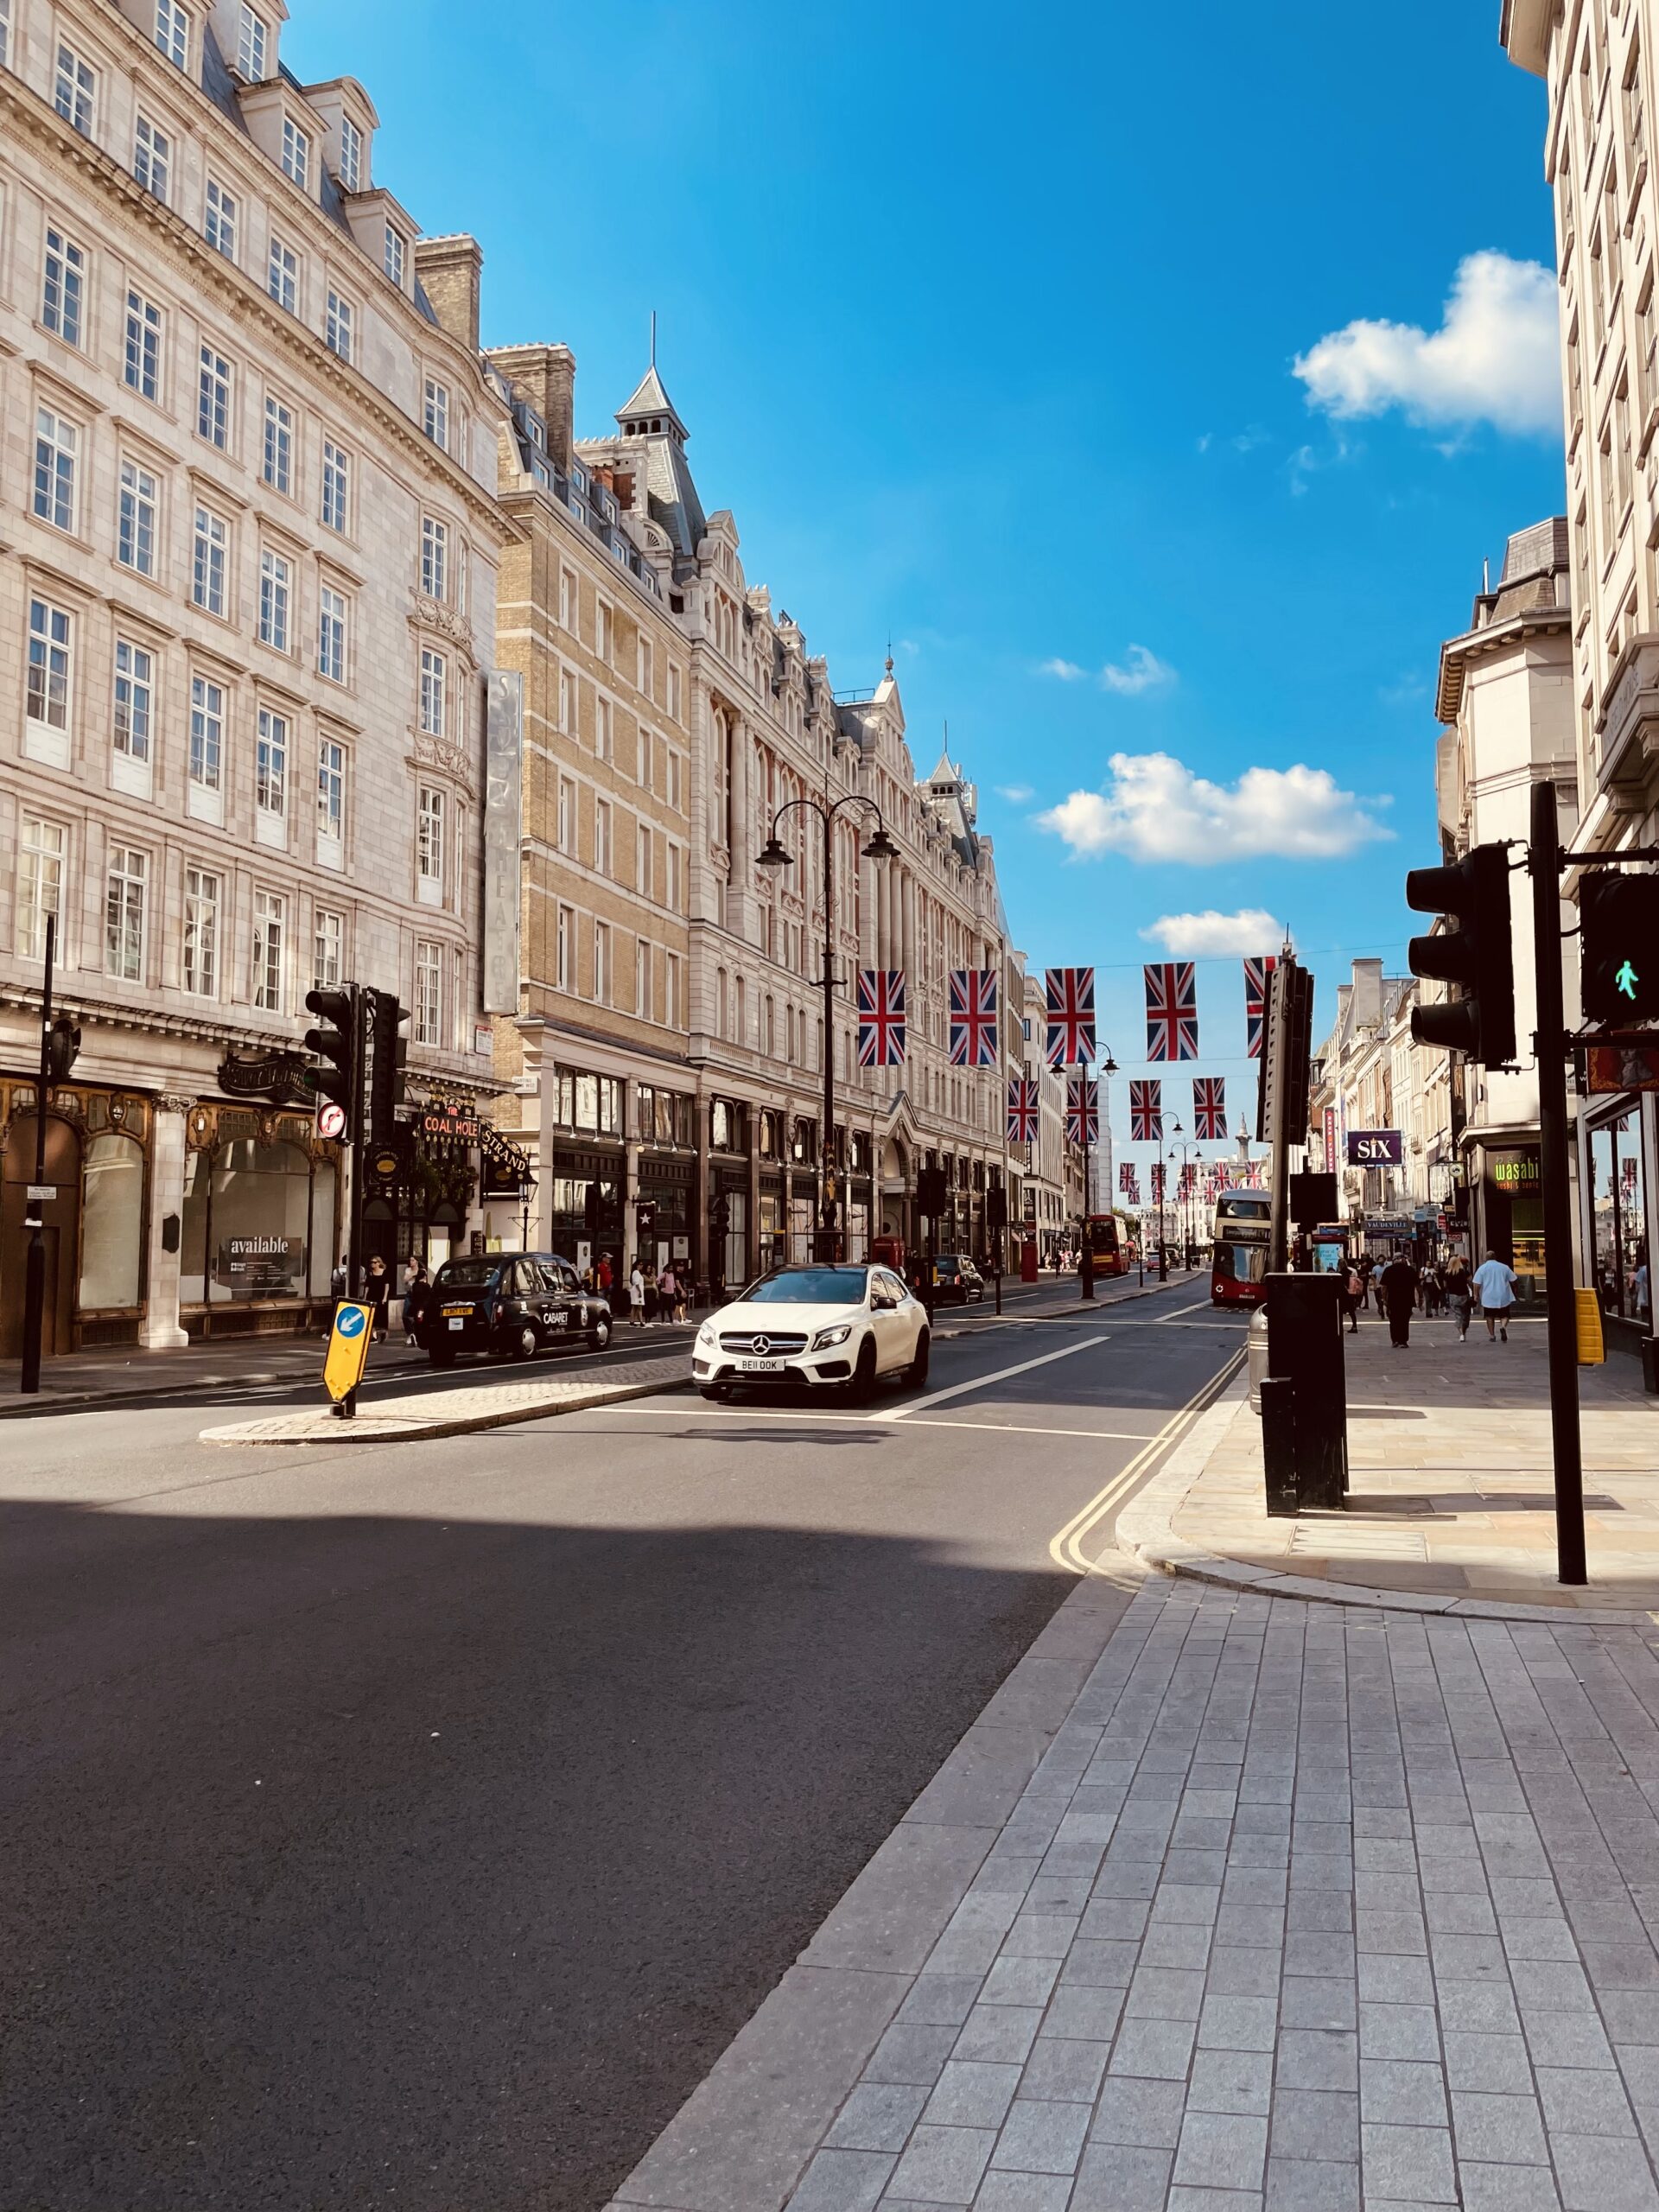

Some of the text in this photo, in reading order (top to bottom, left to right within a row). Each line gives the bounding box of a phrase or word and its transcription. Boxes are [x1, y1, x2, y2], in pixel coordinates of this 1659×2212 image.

[424, 1116, 479, 1137] COAL HOLE
[481, 1129, 526, 1172] STRAND
[1357, 1139, 1393, 1159] SIX
[1495, 1157, 1539, 1181] wasabi
[231, 1236, 289, 1254] available
[543, 1312, 569, 1325] CABARET
